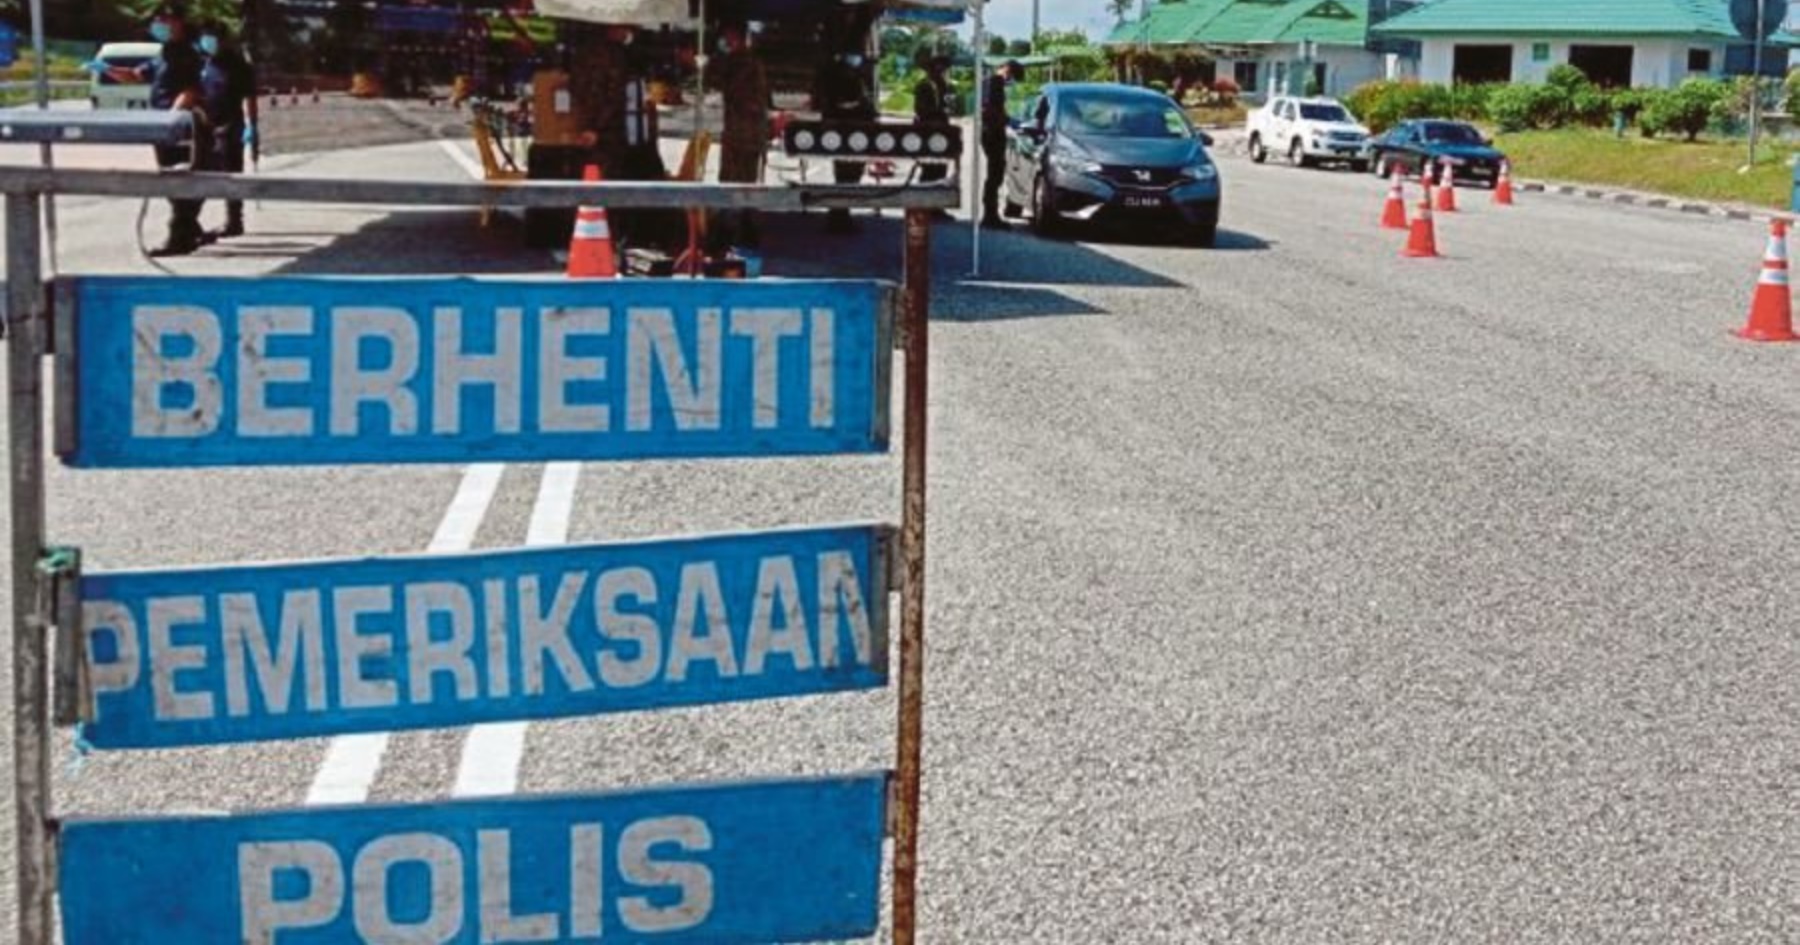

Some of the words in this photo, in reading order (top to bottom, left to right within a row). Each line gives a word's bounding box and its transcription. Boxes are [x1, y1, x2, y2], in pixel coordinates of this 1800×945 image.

[131, 305, 835, 438] BERHENTI
[83, 550, 872, 720] PEMERIKSAAN
[238, 815, 713, 945] POLIS
